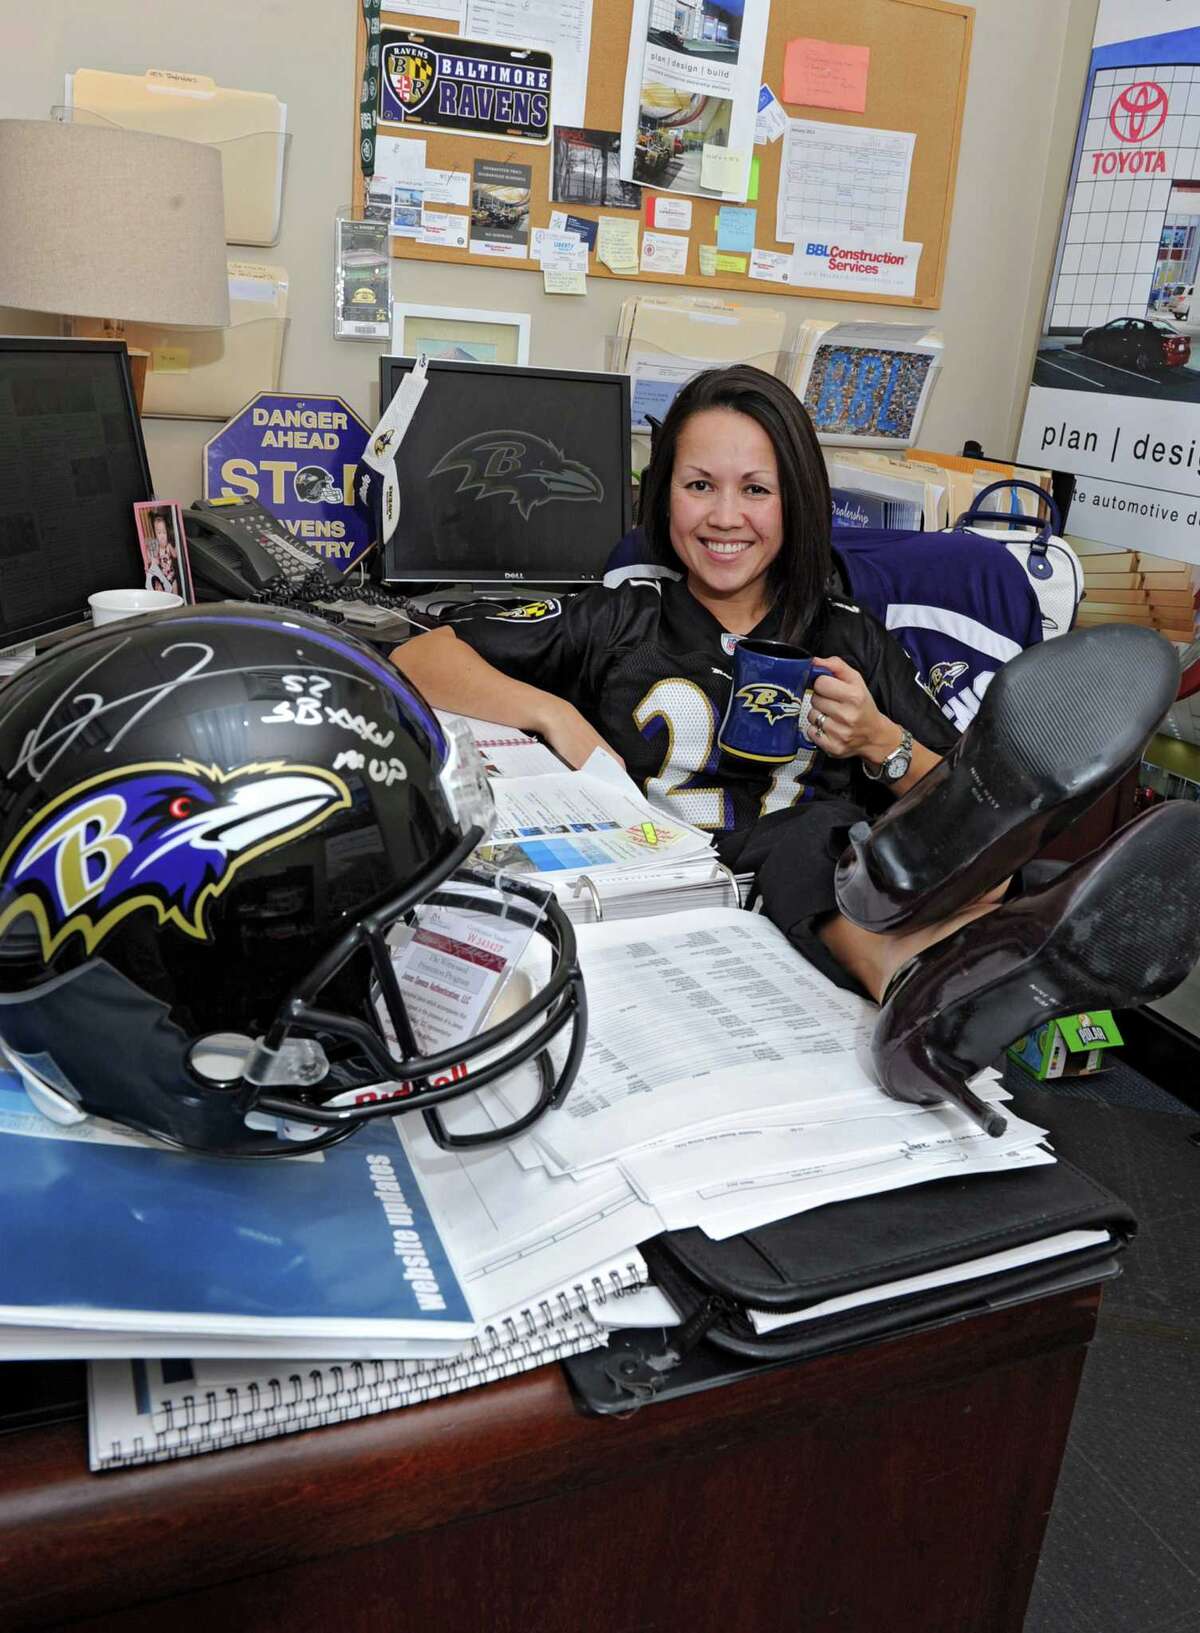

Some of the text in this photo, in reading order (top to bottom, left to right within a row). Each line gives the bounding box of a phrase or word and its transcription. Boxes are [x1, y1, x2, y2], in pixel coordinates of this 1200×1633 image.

[393, 47, 429, 60] RAVENS
[650, 53, 730, 79] plan design build
[441, 58, 548, 89] BALTIMORE
[438, 80, 549, 128] RAVENS
[1092, 150, 1166, 176] TOYOTA
[828, 258, 880, 275] Services
[253, 408, 348, 430] DANGER
[261, 430, 340, 451] AHEAD
[1041, 422, 1098, 451] plan
[1092, 492, 1179, 522] automotive
[504, 572, 525, 580] DELL
[1078, 1026, 1106, 1044] POLAR
[365, 1153, 447, 1311] website updates
